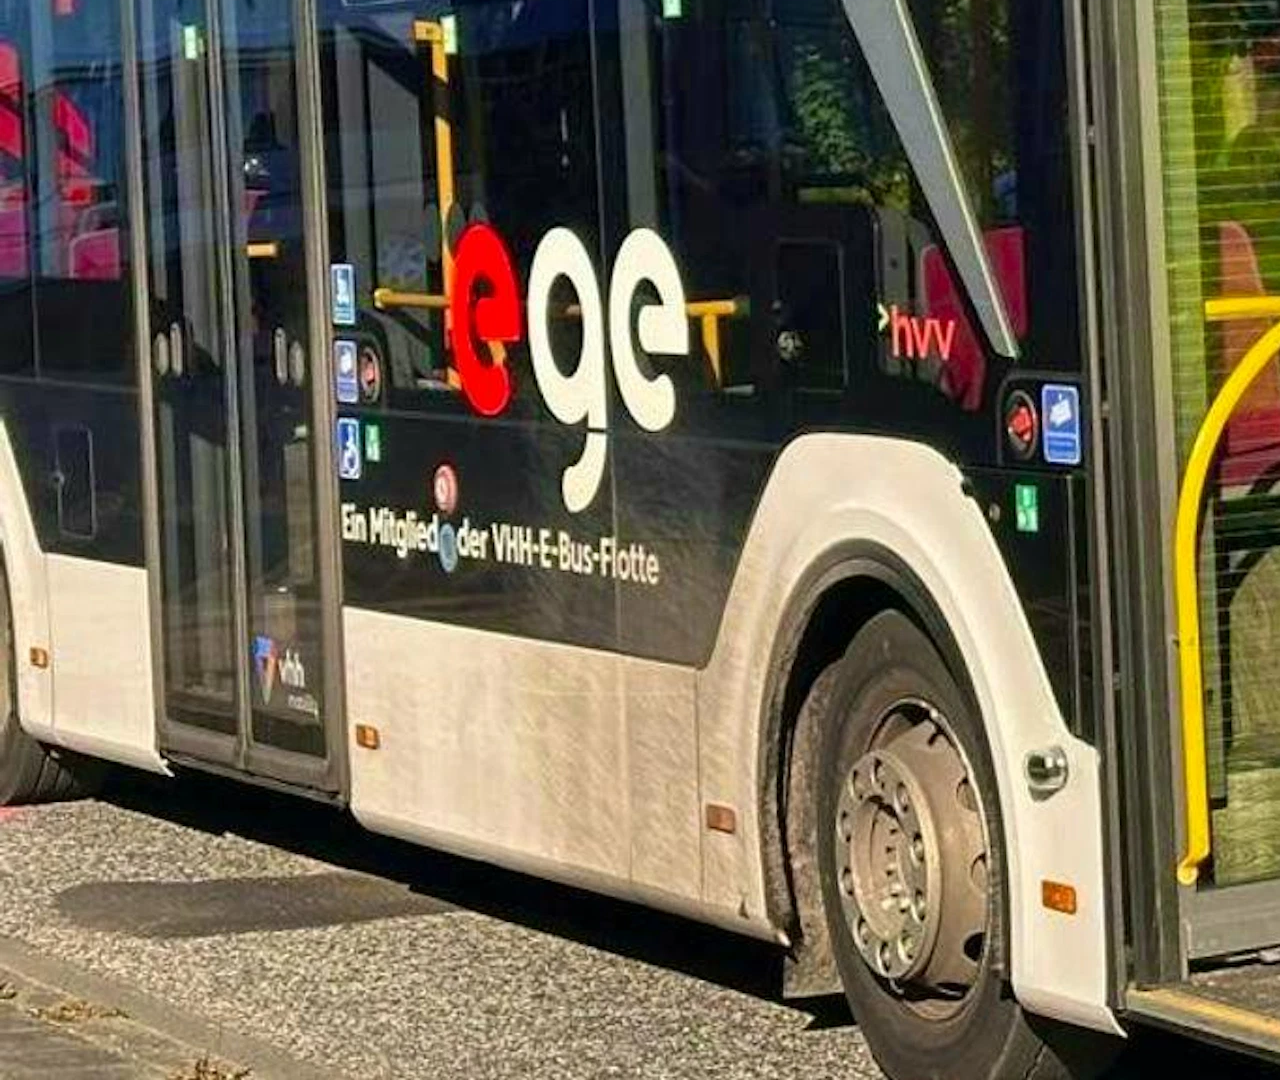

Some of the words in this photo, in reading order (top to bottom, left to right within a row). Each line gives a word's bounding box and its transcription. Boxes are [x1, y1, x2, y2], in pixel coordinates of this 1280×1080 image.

[341, 503, 367, 543] Ein
[370, 507, 439, 558] Mitglied
[456, 518, 489, 560] der
[492, 522, 660, 584] VHH-E-Bus-Flotte
[278, 648, 306, 689] vhh
